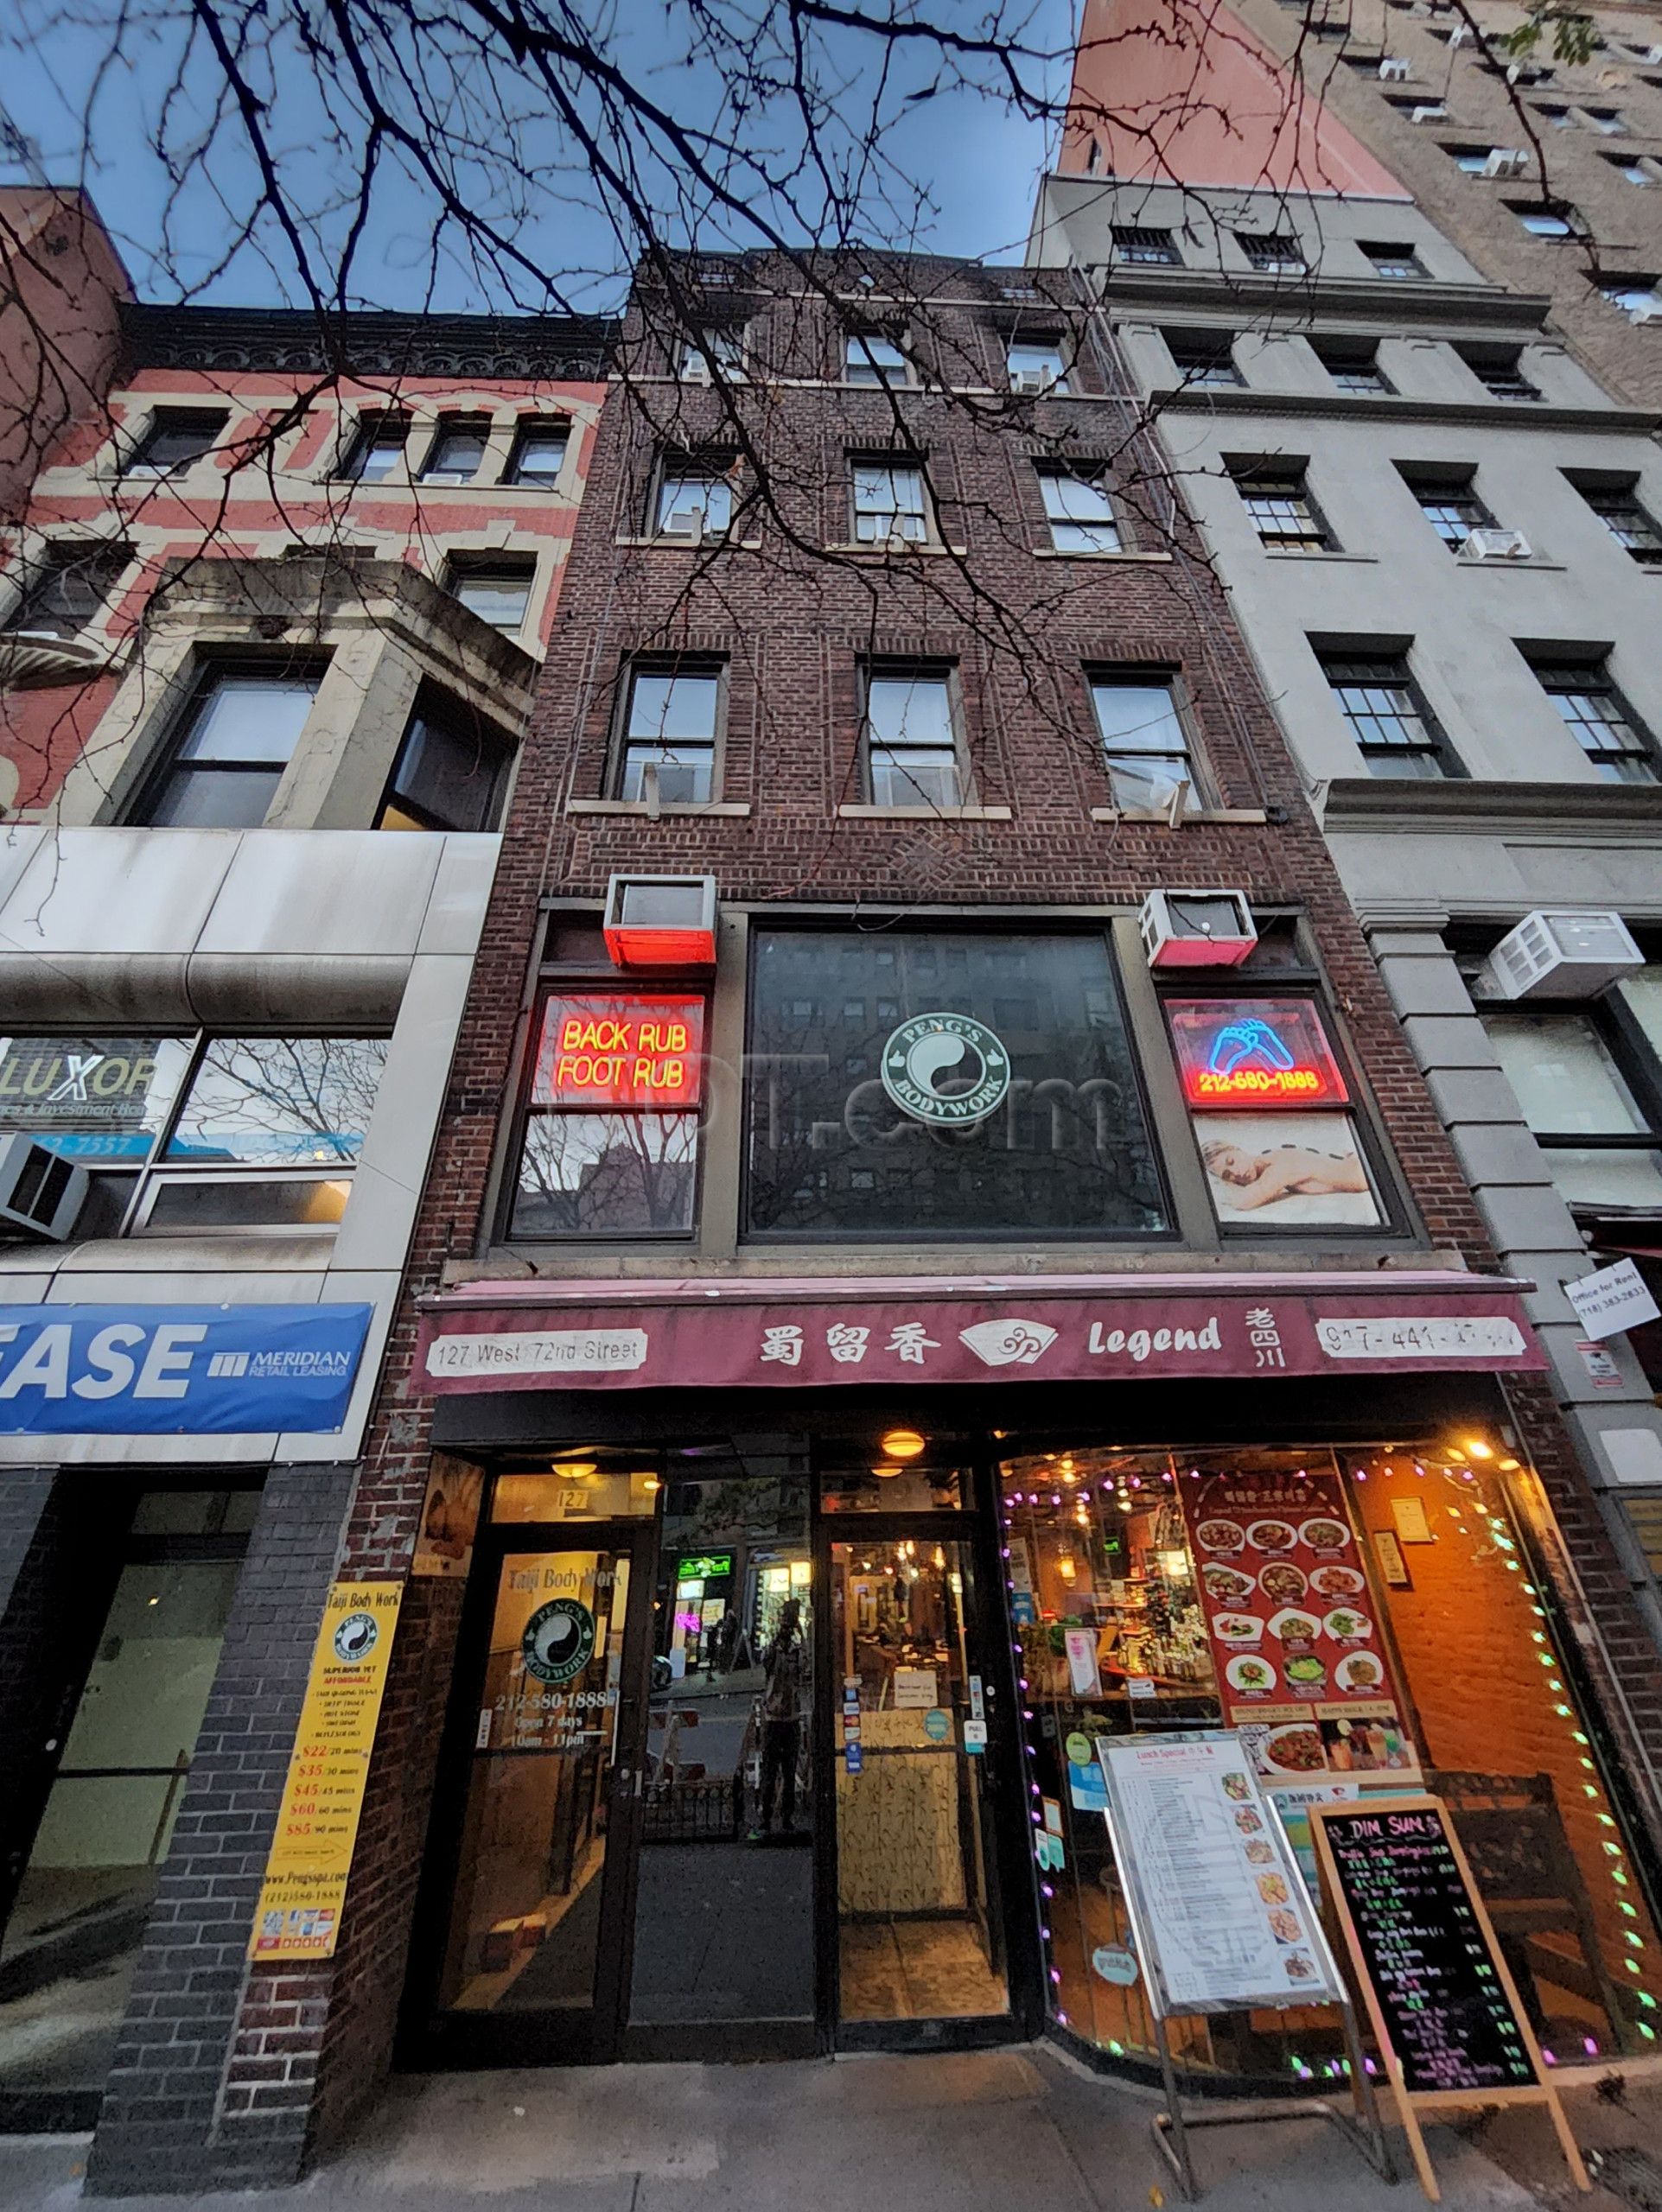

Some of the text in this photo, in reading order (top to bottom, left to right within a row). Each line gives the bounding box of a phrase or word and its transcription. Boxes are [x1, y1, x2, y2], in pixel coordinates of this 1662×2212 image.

[564, 1020, 687, 1052] BACK RUB
[902, 1019, 983, 1043] PENG'S
[0, 1055, 159, 1096] LUXOR
[557, 1055, 685, 1089] FOOT RUB
[895, 1075, 1003, 1116] BODYWORK
[760, 1321, 943, 1366] 蜀留香
[1087, 1318, 1222, 1362] Legend
[1245, 1308, 1286, 1368] 老四川
[0, 1324, 207, 1399] ASE
[252, 1351, 351, 1367] MERIDIAN
[438, 1339, 638, 1366] 127 West 72nd Street
[249, 1365, 347, 1377] RETAIL LEASING
[557, 1491, 585, 1508] 127
[544, 1568, 577, 1592] Body
[349, 1592, 372, 1611] Body
[375, 1591, 398, 1607] Work
[494, 1691, 608, 1711] 212-580-1888
[547, 1714, 555, 1727] 7
[1349, 1815, 1426, 1840] DIM SUM
